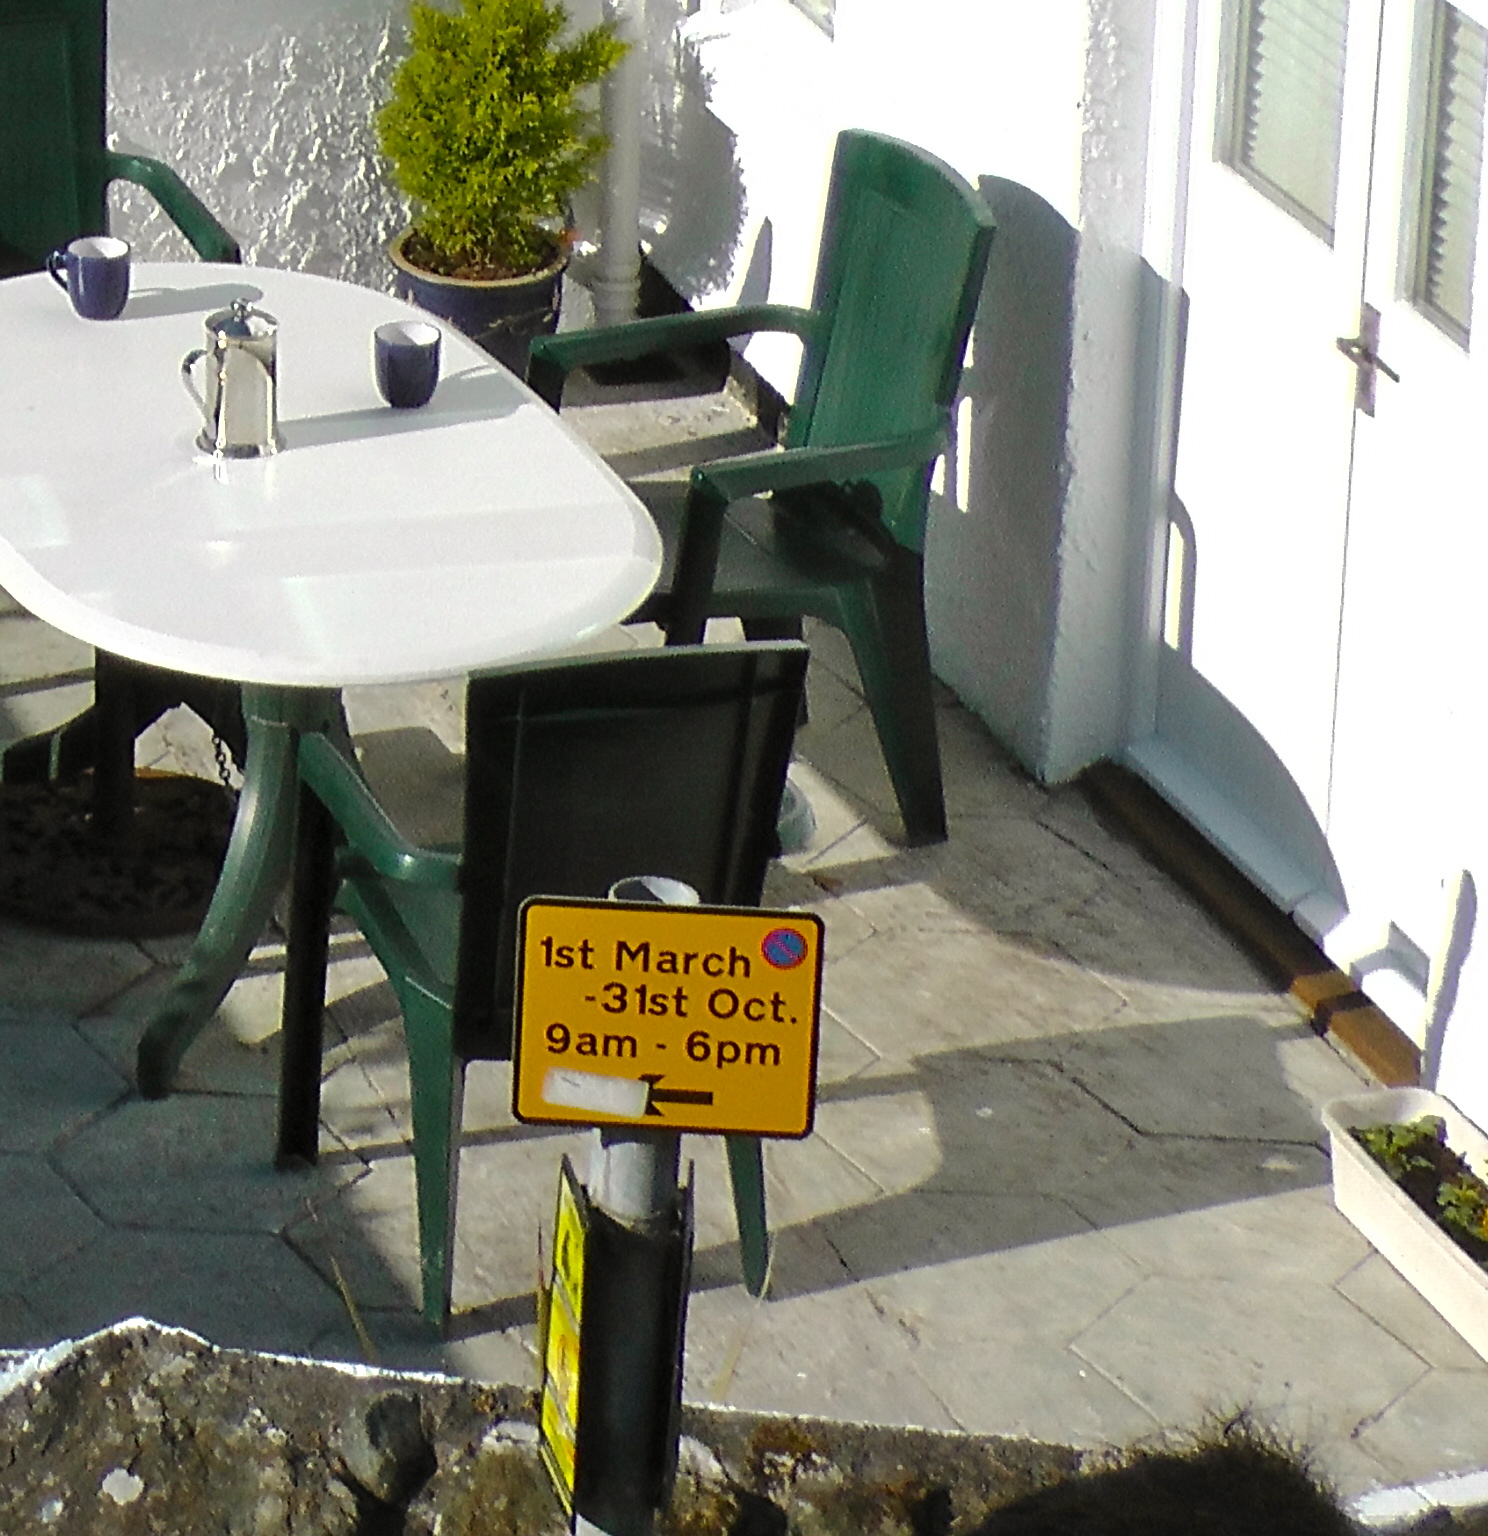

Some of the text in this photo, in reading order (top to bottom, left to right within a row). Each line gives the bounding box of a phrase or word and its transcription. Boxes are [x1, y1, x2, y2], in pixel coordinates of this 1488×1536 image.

[540, 935, 751, 979] 1st March
[707, 987, 798, 1025] Oct.
[545, 1022, 638, 1059] 9am
[686, 1030, 781, 1070] 6pm
